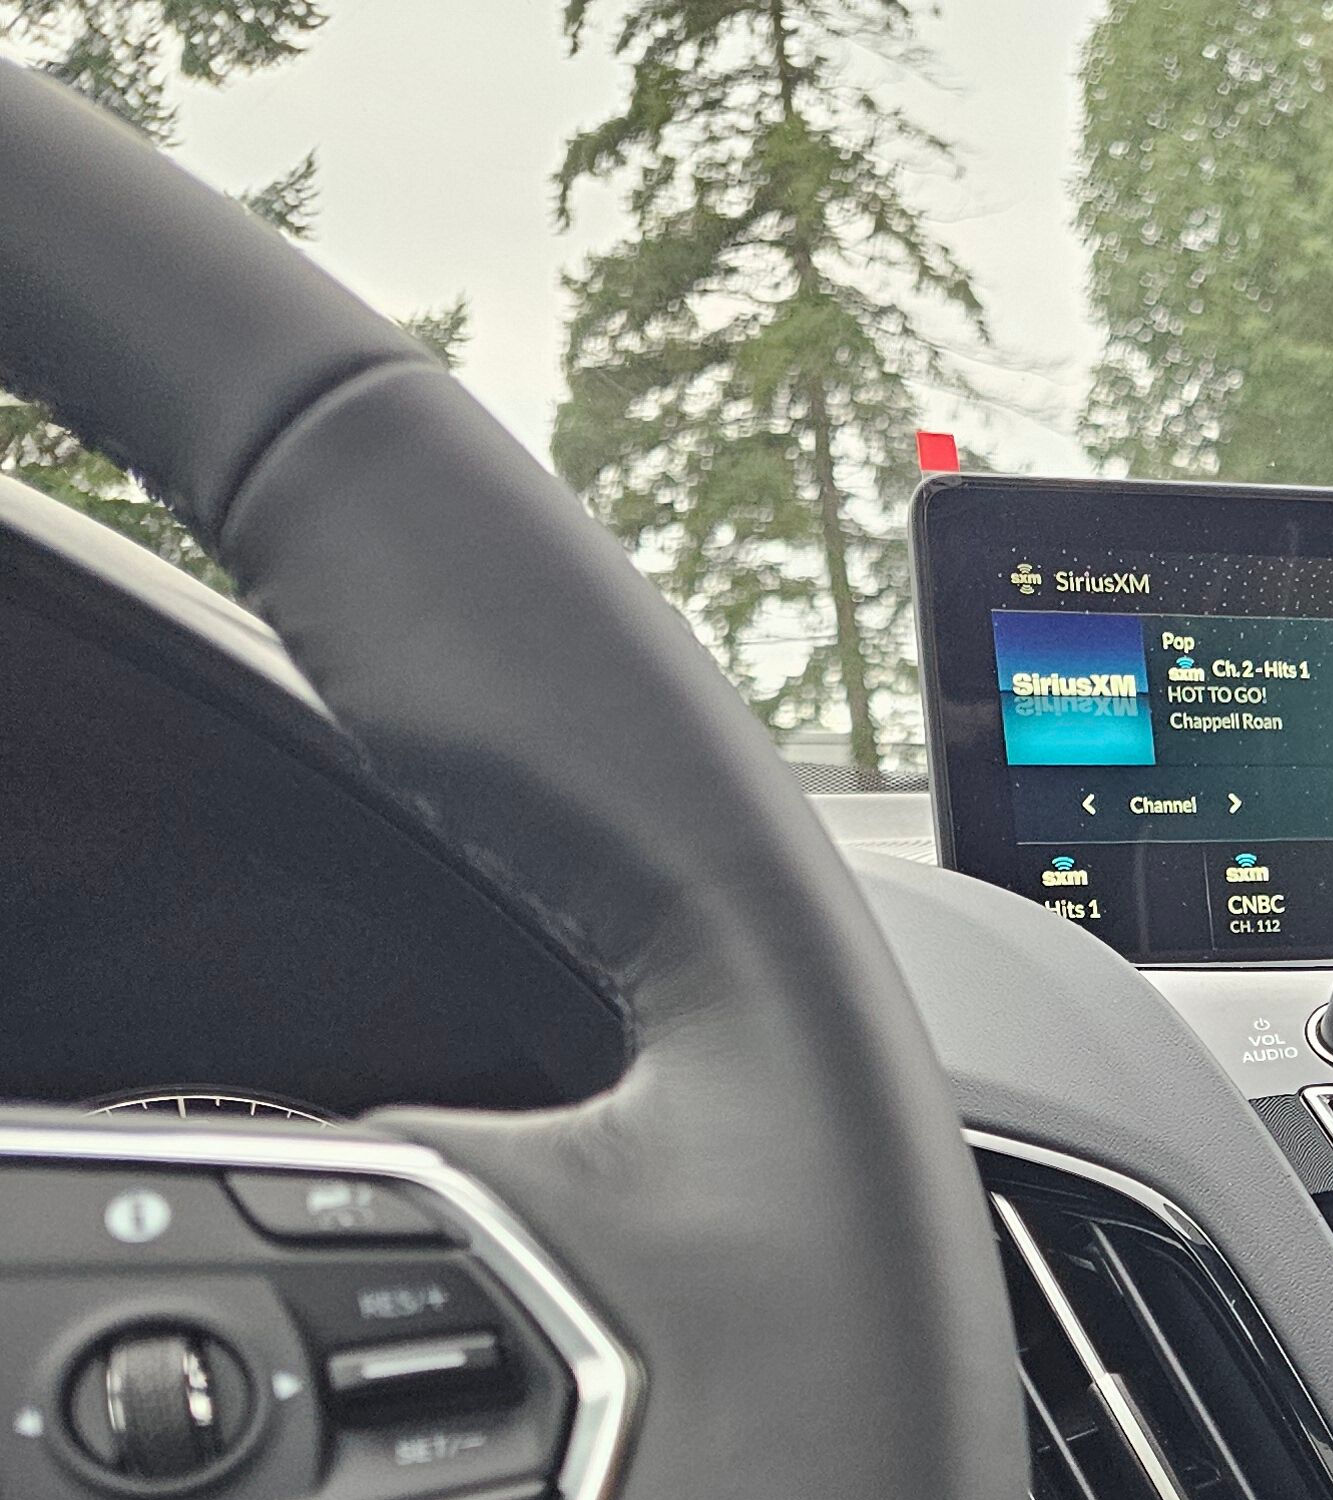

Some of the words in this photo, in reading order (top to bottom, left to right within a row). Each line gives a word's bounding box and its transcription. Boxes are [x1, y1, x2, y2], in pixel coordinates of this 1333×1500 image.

[1056, 571, 1149, 593] SiriusXM
[1162, 632, 1195, 653] Pop
[1264, 661, 1297, 679] Hits
[1299, 661, 1310, 679] 1
[1012, 673, 1137, 697] SiriusXM
[1168, 686, 1205, 703] HOT
[1207, 686, 1232, 704] TO
[1234, 687, 1267, 704] GO!
[1170, 712, 1239, 733] Chappell
[1242, 713, 1283, 730] Roan
[1130, 796, 1197, 814] Channel
[1088, 900, 1100, 918] 1
[1228, 895, 1285, 914] CNBC
[1230, 921, 1254, 933] CH.
[1257, 920, 1280, 932] 112
[1249, 1033, 1286, 1048] VOL
[1242, 1046, 1299, 1064] AUDIO
